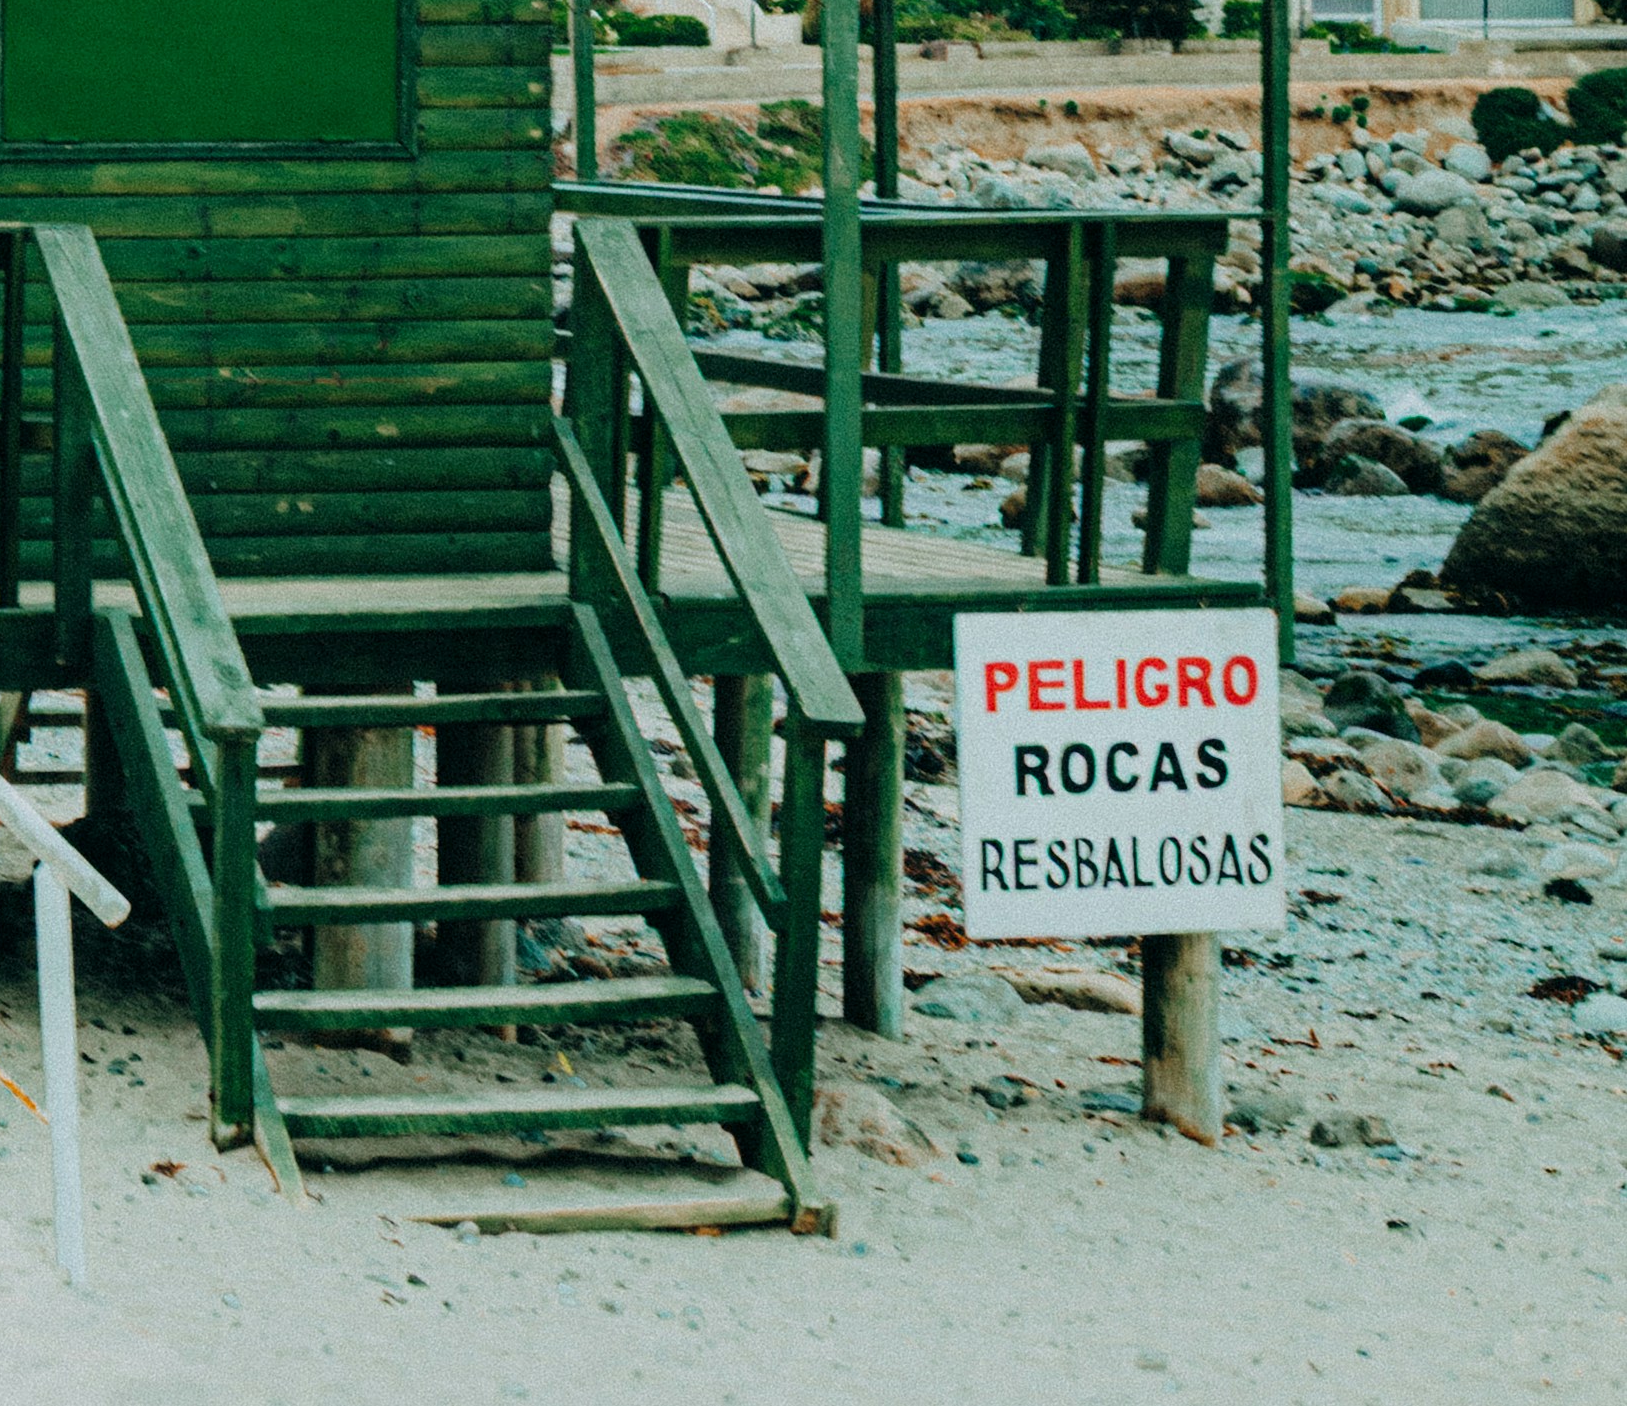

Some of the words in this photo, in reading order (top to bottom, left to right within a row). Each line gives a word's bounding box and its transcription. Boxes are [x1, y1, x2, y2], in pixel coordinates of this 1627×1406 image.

[983, 655, 1260, 713] PELIGRO
[1014, 738, 1230, 797] ROCAS
[980, 832, 1274, 892] RESBALOSAS
